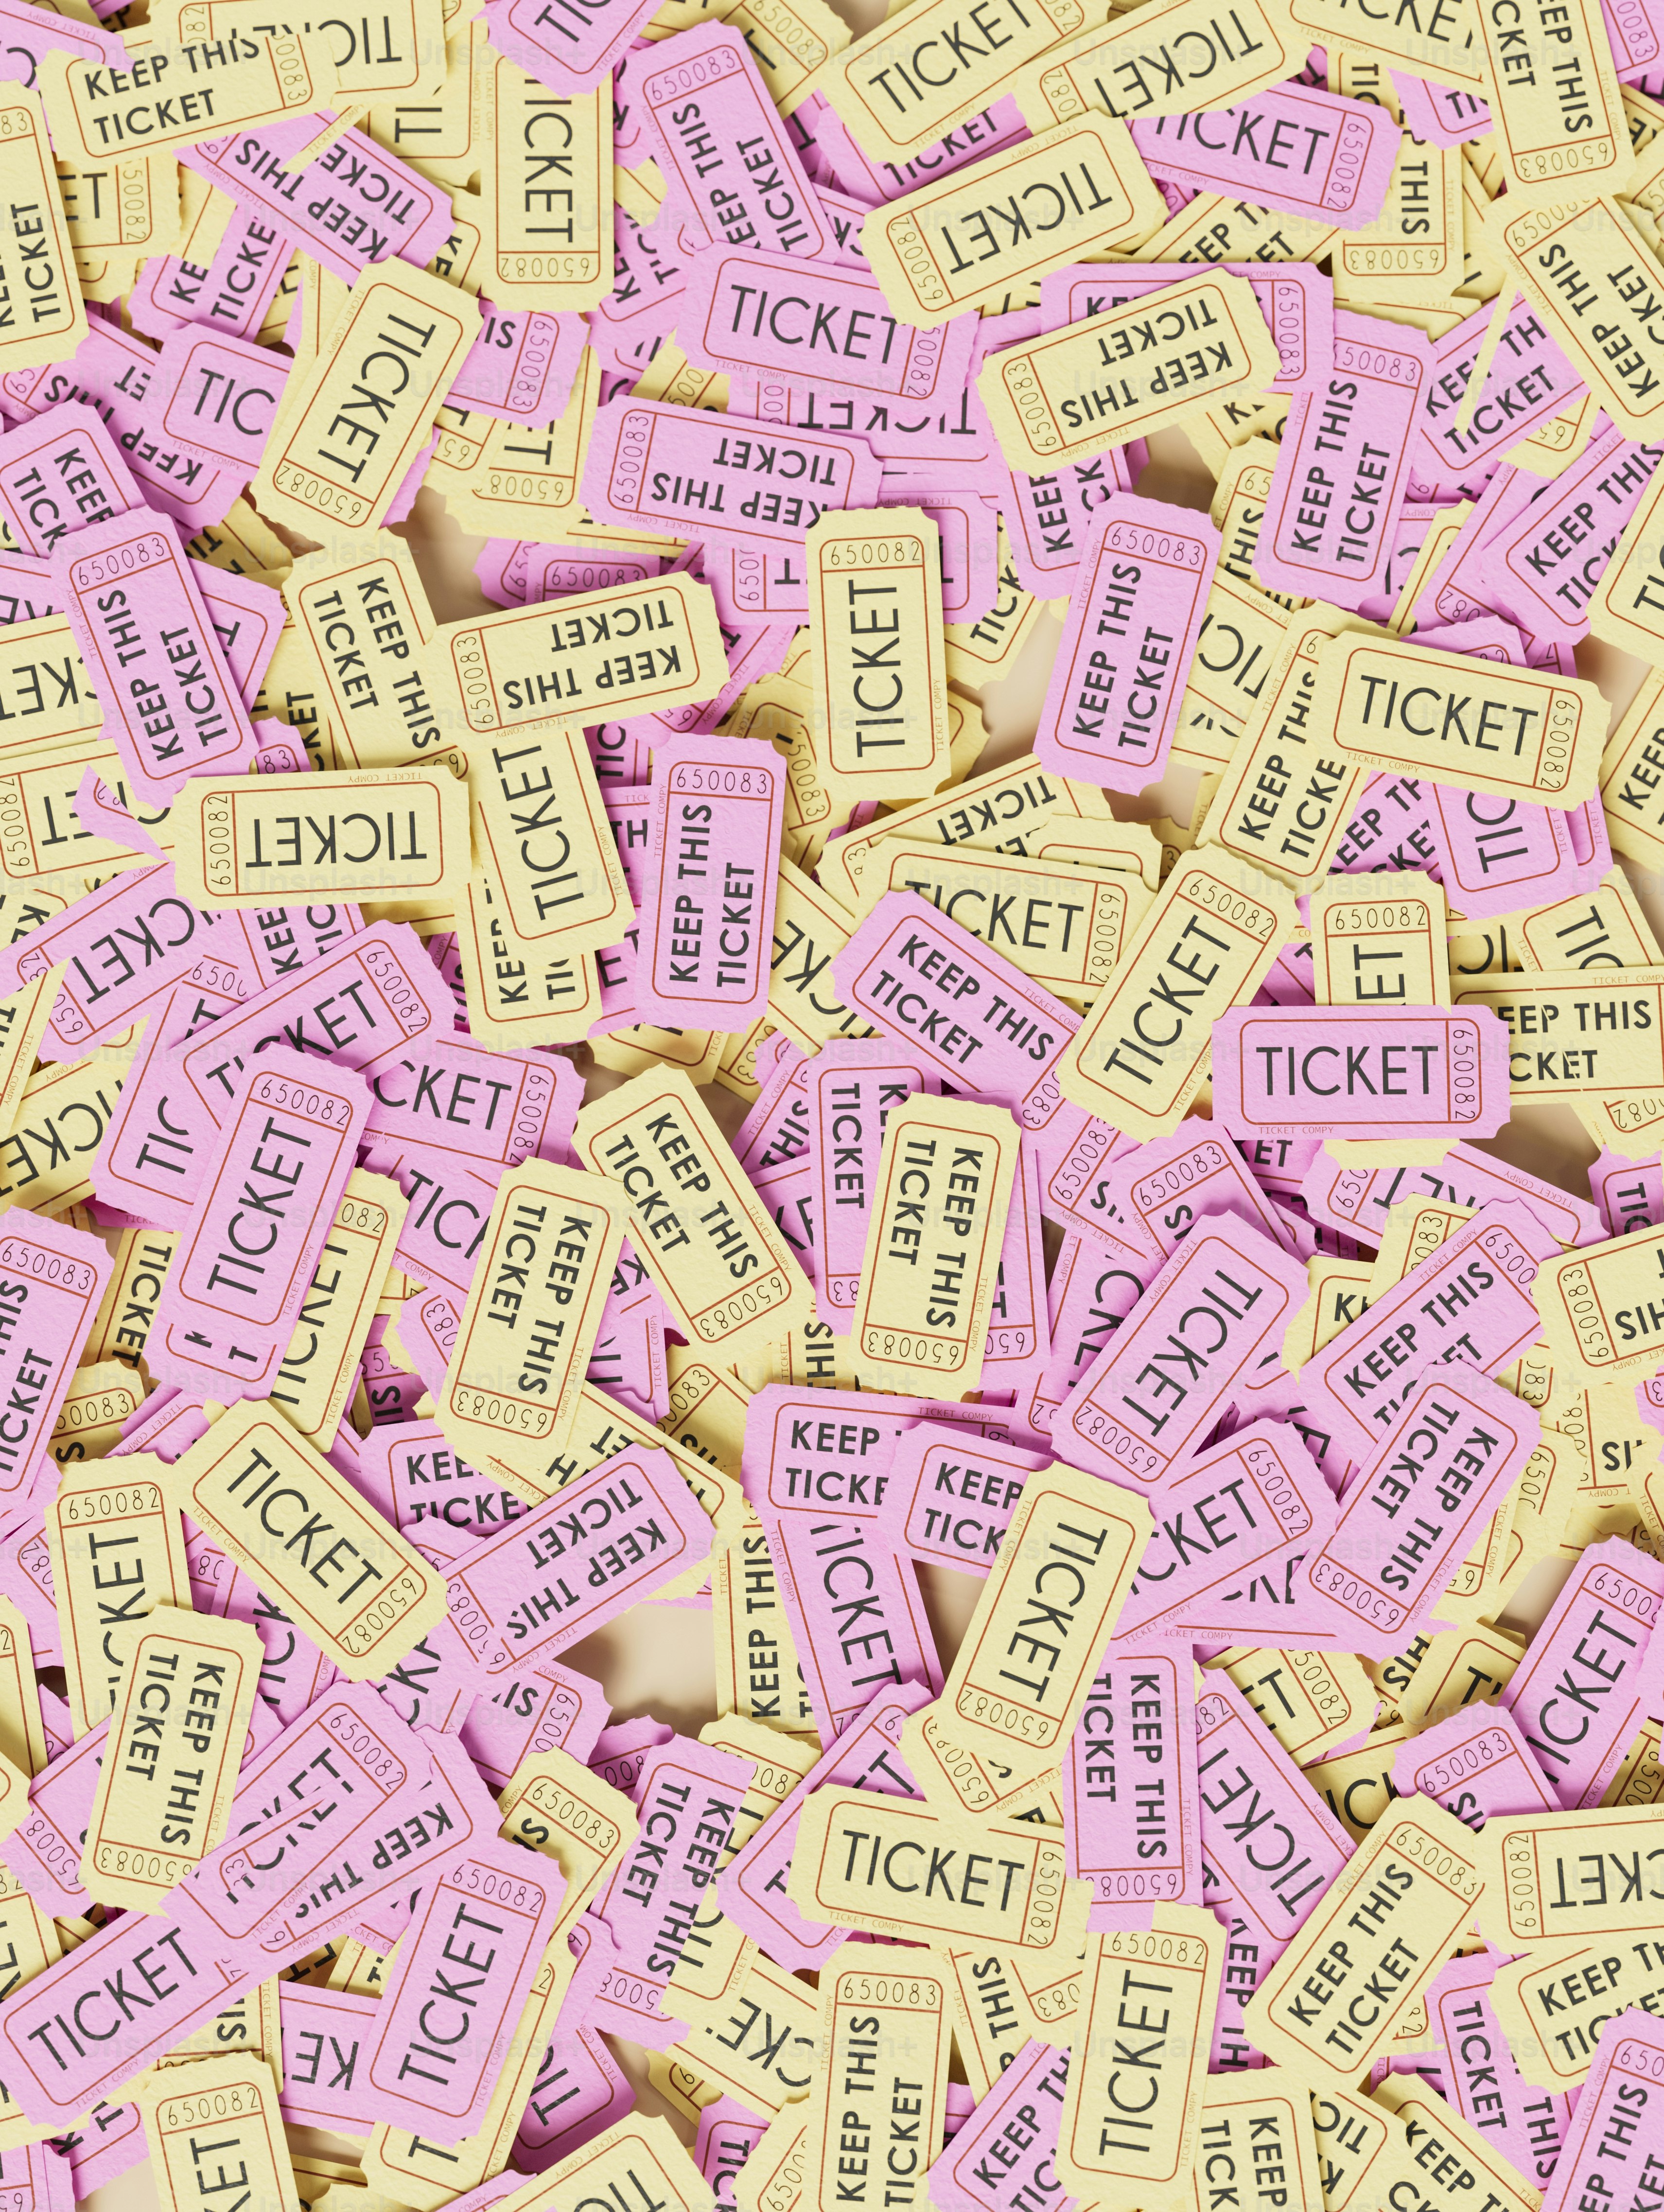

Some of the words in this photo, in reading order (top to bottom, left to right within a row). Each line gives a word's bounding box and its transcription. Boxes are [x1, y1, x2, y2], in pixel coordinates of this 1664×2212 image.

[652, 53, 735, 100] 650083
[1553, 58, 1592, 132] THIS
[94, 89, 213, 143] TICKET
[673, 104, 722, 178] THIS
[736, 137, 807, 251] TICKET
[1521, 143, 1607, 177] 650083
[308, 197, 387, 260] KEEP
[942, 163, 1112, 274] TICKET
[1401, 162, 1429, 233] THIS
[11, 205, 60, 322] TICKET
[502, 258, 589, 277] 650082
[891, 218, 943, 299] 650082
[1351, 250, 1438, 269] 650083
[1540, 245, 1598, 316] THIS
[513, 321, 552, 406] 650083
[1099, 300, 1217, 366] TICKET
[1151, 342, 1231, 394] KEEP
[1593, 325, 1659, 397] KEEP
[318, 315, 436, 482] TICKET
[1008, 364, 1056, 446] 650083
[1061, 380, 1138, 427] THIS
[277, 466, 361, 519] 650082
[614, 417, 648, 503] 650083
[652, 473, 724, 512] THIS
[714, 439, 835, 485] TICKET
[1112, 527, 1199, 565] 650083
[1292, 467, 1334, 552] KEEP
[79, 538, 164, 585] 650083
[831, 542, 919, 565] 650082
[98, 591, 146, 667] THIS
[315, 591, 378, 708] TICKET
[358, 578, 409, 658] KEEP
[552, 601, 673, 652] TICKET
[1073, 651, 1117, 737] KEEP
[1097, 564, 1140, 635] THIS
[160, 628, 227, 746] TICKET
[457, 637, 493, 723] 650083
[504, 669, 581, 709] THIS
[596, 646, 681, 688] KEEP
[849, 580, 905, 757] TICKET
[933, 679, 942, 709] COMPY
[1118, 627, 1173, 747] TICKET
[131, 679, 183, 761] KEEP
[935, 716, 944, 752] TICKET
[1361, 675, 1538, 755] TICKET
[1541, 701, 1575, 788] 650082
[658, 784, 666, 814] COMPY
[677, 768, 766, 793] 650083
[1238, 755, 1291, 840] KEEP
[1346, 752, 1383, 765] TICKET
[1389, 761, 1419, 773] COMPY
[208, 796, 231, 885] 650082
[246, 811, 426, 867] TICKET
[493, 746, 583, 920] TICKET
[654, 821, 664, 858] TICKET
[678, 805, 711, 879] THIS
[670, 895, 703, 982] KEEP
[717, 863, 753, 987] TICKET
[1190, 879, 1274, 937] 650082
[1336, 906, 1425, 930] 650082
[367, 951, 427, 1032] 650082
[898, 934, 980, 1000] KEEP
[1104, 915, 1230, 1084] TICKET
[1575, 1001, 1651, 1031] THIS
[262, 1080, 349, 1125] 650082
[1257, 1046, 1438, 1095] TICKET
[1454, 1030, 1475, 1119] 650082
[832, 1083, 864, 1208] TICKET
[1140, 1146, 1221, 1206] 650083
[207, 1117, 311, 1294] TICKET
[606, 1135, 690, 1251] TICKET
[646, 1113, 710, 1192] KEEP
[700, 1201, 757, 1278] THIS
[889, 1141, 936, 1265] TICKET
[944, 1148, 983, 1236] KEEP
[282, 1280, 301, 1315] TICKET
[298, 1244, 314, 1274] COMPY
[488, 1206, 546, 1329] TICKET
[545, 1216, 592, 1304] KEEP
[927, 1253, 966, 1327] THIS
[1419, 1253, 1449, 1281] TICKET
[1453, 1229, 1477, 1252] COMPY
[650, 1316, 659, 1345] COMPY
[701, 1277, 782, 1337] 650083
[1344, 1324, 1418, 1398] KEEP
[1421, 1263, 1493, 1327] THIS
[1563, 1270, 1609, 1357] 650083
[519, 1320, 564, 1394] THIS
[652, 1352, 662, 1389] TICKET
[869, 1332, 958, 1365] 650083
[1122, 1270, 1262, 1437] TICKET
[458, 1391, 546, 1432] 650083
[918, 1407, 956, 1417] TICKET
[962, 1412, 993, 1421] COMPY
[1076, 1406, 1156, 1473] 650082
[1249, 1451, 1308, 1534] 650082
[1371, 1403, 1459, 1519] TICKET
[1435, 1427, 1498, 1511] KEEP
[70, 1488, 158, 1519] 650082
[228, 1448, 382, 1604] TICKET
[1381, 1518, 1443, 1591] THIS
[342, 1579, 416, 1653] 650082
[1316, 1564, 1399, 1626] 650083
[183, 1663, 225, 1753] KEEP
[749, 1630, 780, 1717] KEEP
[126, 1655, 178, 1780] TICKET
[331, 1714, 403, 1789] 650082
[960, 1690, 1048, 1740] 650082
[1131, 1675, 1162, 1763] KEEP
[1424, 1733, 1506, 1792] 650083
[161, 1770, 203, 1844] THIS
[533, 1783, 614, 1848] 650083
[683, 1798, 735, 1887] KEEP
[1136, 1779, 1167, 1858] THIS
[1183, 1798, 1191, 1836] TICKET
[623, 1783, 691, 1907] TICKET
[843, 1830, 1024, 1911] TICKET
[1185, 1844, 1193, 1875] COMPY
[1508, 1836, 1536, 1927] 650082
[453, 1864, 542, 1912] 650082
[829, 1911, 866, 1924] TICKET
[872, 1920, 904, 1931] COMPY
[1028, 1852, 1062, 1944] 650082
[1349, 1864, 1412, 1936] THIS
[28, 1928, 196, 2070] TICKET
[398, 1903, 503, 2085] TICKET
[824, 1995, 833, 2026] COMPY
[844, 1978, 935, 2005] 650083
[1288, 1942, 1353, 2026] KEEP
[1326, 1937, 1418, 2053] TICKET
[1538, 1957, 1621, 2016] KEEP
[821, 2033, 830, 2071] TICKET
[845, 2017, 879, 2094] THIS
[1100, 1970, 1172, 2155] TICKET
[169, 2088, 258, 2125] 650082
[1579, 2091, 1596, 2127] TICKET
[1594, 2054, 1609, 2086] COMPY
[837, 2111, 870, 2201] KEEP
[885, 2077, 922, 2207] TICKET
[973, 2106, 1040, 2189] KEEP
